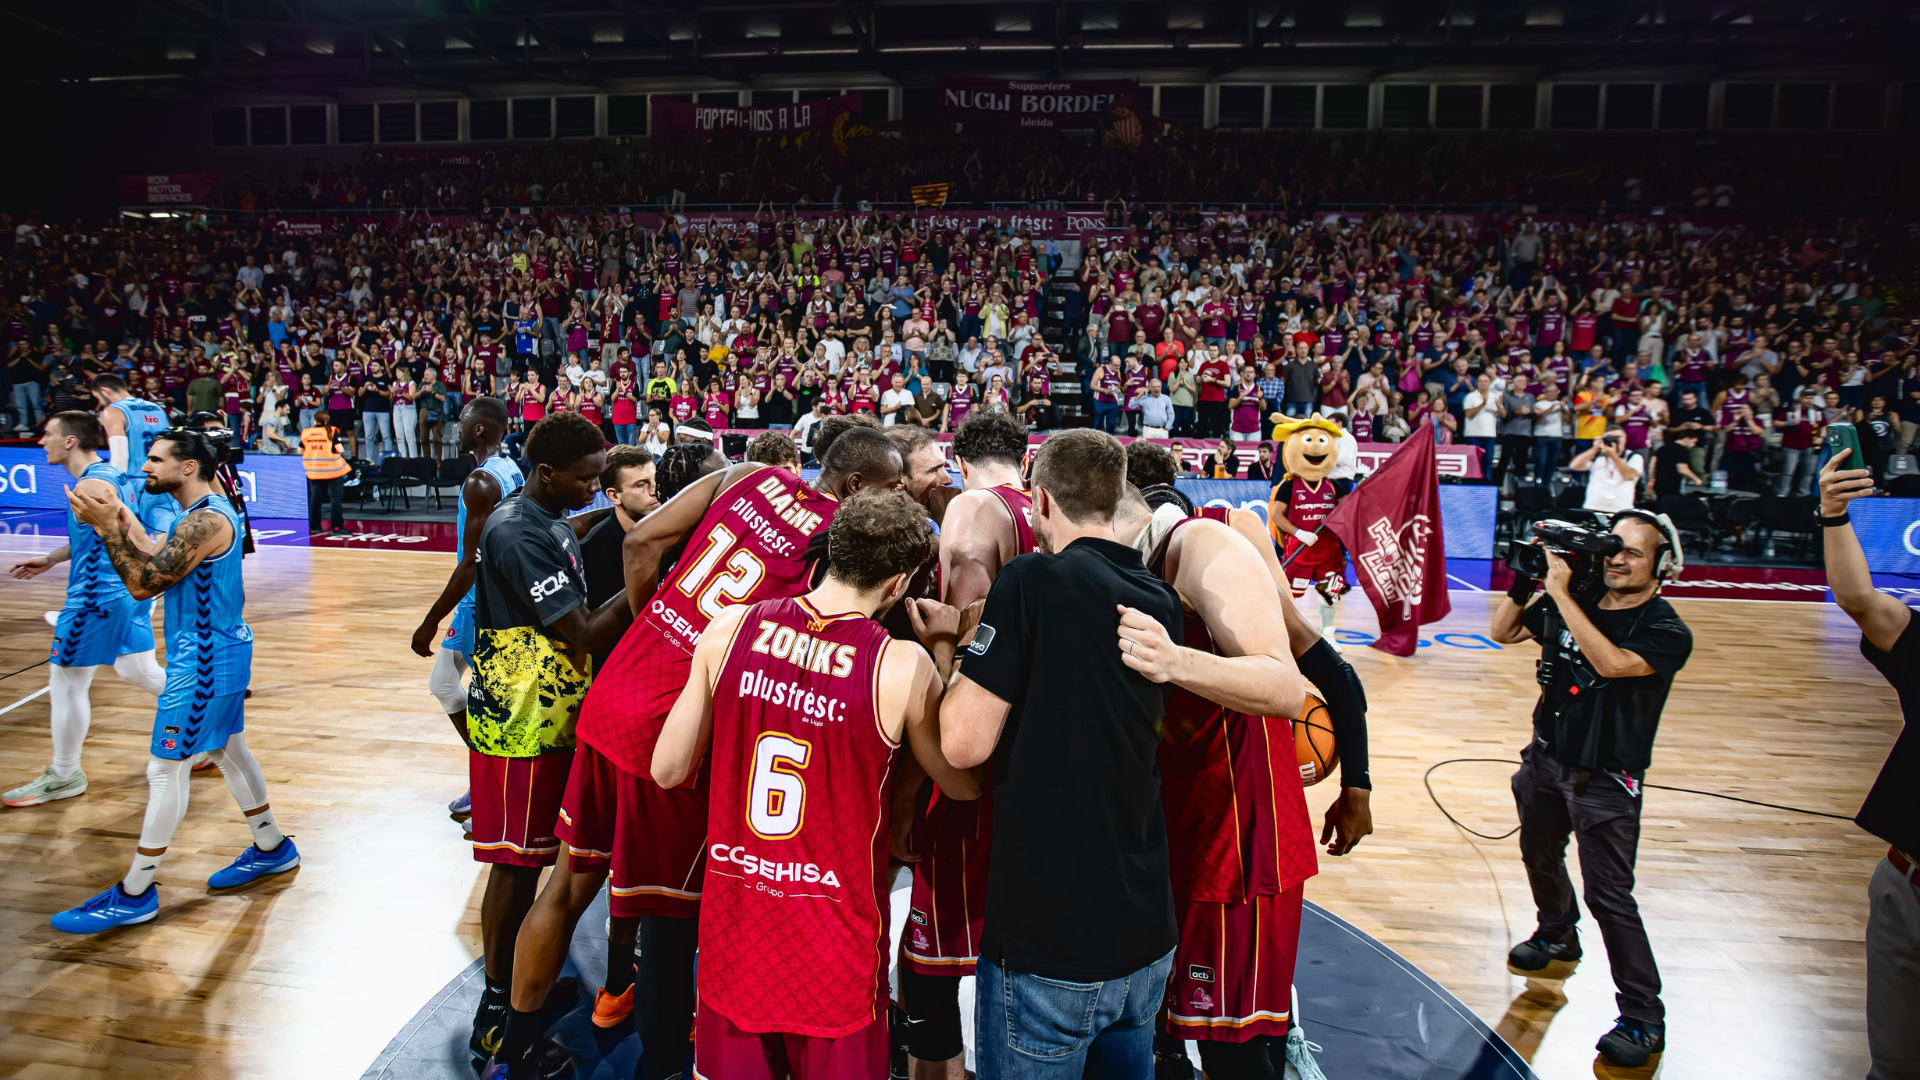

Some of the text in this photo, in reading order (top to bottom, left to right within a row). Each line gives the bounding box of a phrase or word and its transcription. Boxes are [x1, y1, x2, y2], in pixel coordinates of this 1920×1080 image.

[1008, 81, 1071, 91] Supporters
[779, 107, 788, 129] A
[794, 105, 811, 128] LA
[1020, 117, 1054, 127] Lleida
[147, 175, 170, 185] RODI
[147, 184, 182, 193] MOTOR
[147, 193, 193, 203] SERVICES
[1066, 215, 1106, 231] PONS
[756, 475, 824, 537] DIAGNE
[675, 522, 766, 621] 12
[663, 630, 681, 648] Grupo
[752, 619, 857, 678] ZORIKS
[745, 730, 812, 841] 6
[755, 881, 785, 899] Grupo
[1191, 968, 1210, 979] acb
